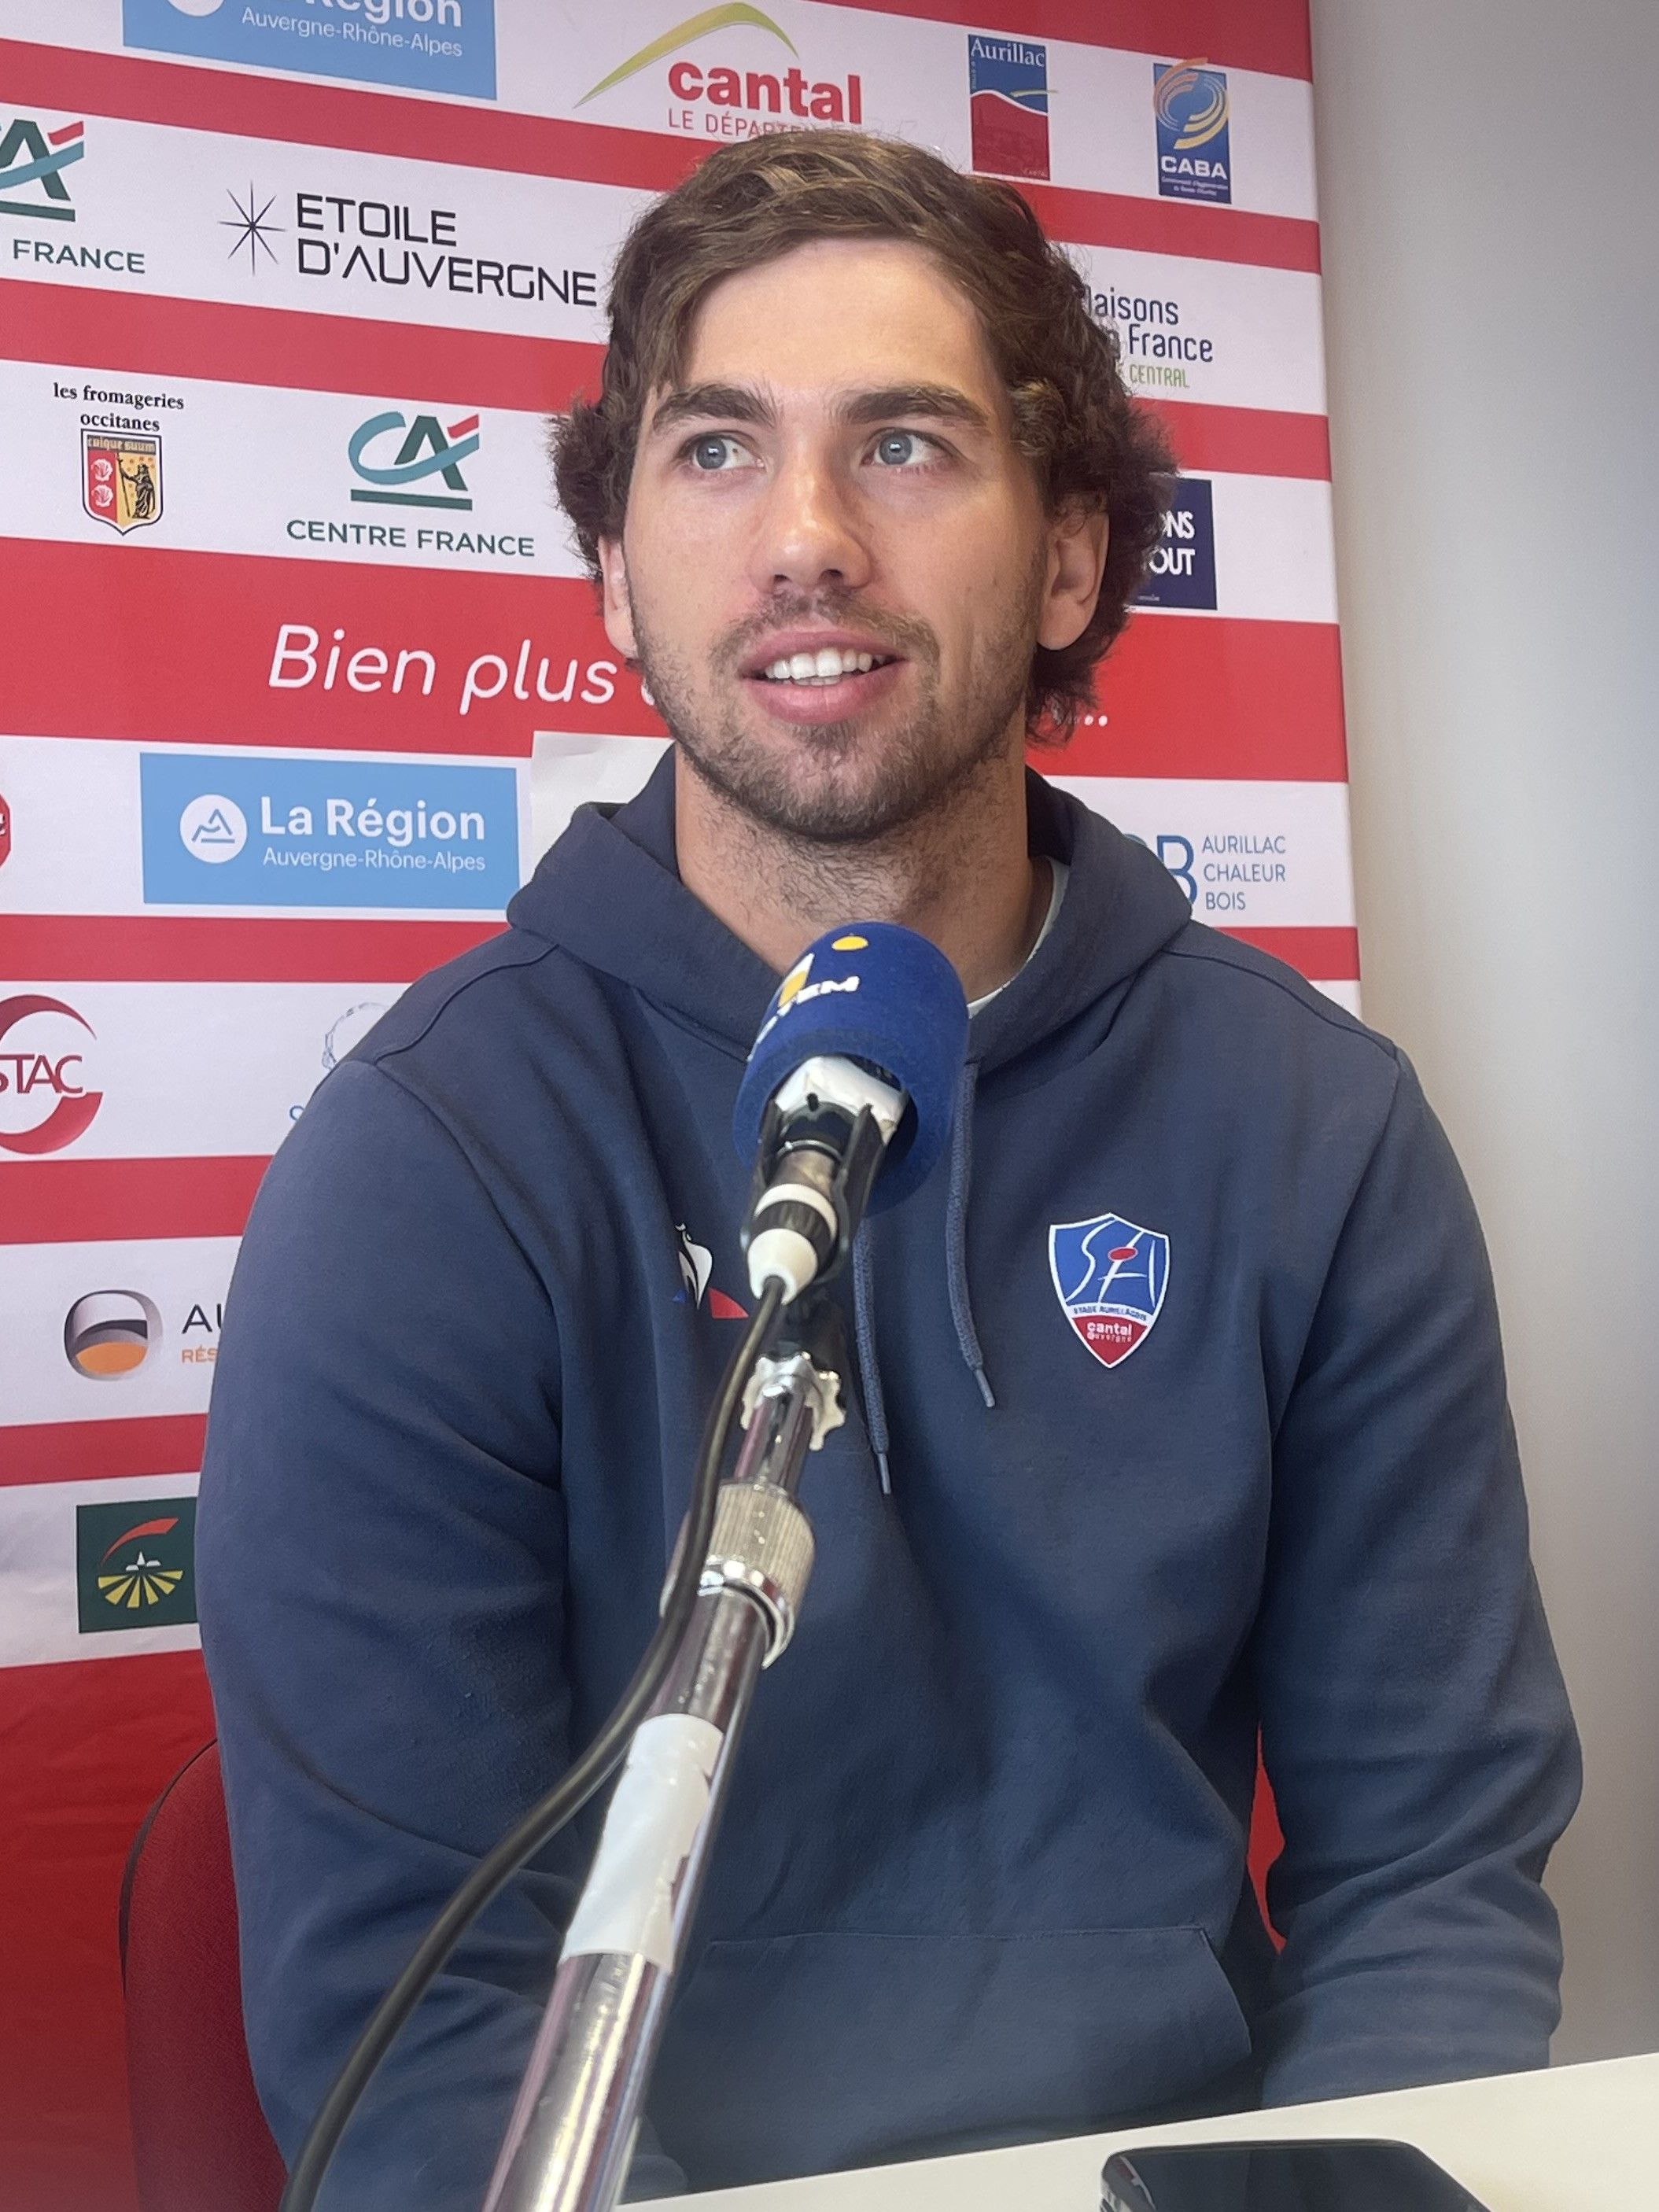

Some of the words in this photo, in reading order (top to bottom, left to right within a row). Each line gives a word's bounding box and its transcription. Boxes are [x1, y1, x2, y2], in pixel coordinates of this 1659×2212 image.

[242, 10, 463, 57] Auvergne-Rhône-Alpes
[971, 37, 1045, 67] Aurillac
[669, 61, 861, 124] cantal
[669, 109, 694, 130] LE
[1161, 156, 1227, 180] CABA
[297, 193, 457, 247] ETOILE
[13, 240, 145, 274] FRANCE
[299, 239, 597, 307] D'AUVERGNE
[1128, 323, 1213, 363] France
[1129, 363, 1190, 389] CENTRAL
[53, 382, 78, 400] les
[83, 385, 184, 410] fromageries
[80, 413, 160, 432] occitanes
[286, 519, 406, 548] CENTRE
[417, 529, 536, 557] FRANCE
[268, 625, 436, 695] Bien
[459, 639, 617, 715] plus
[260, 796, 312, 836] La
[326, 798, 485, 846] Région
[263, 846, 486, 872] Auvergne-Rhône-Alpes
[1202, 835, 1286, 854] AURILLAC
[1204, 864, 1285, 883] CHALEUR
[1205, 892, 1246, 911] BOIS
[1087, 1322, 1132, 1336] cantal
